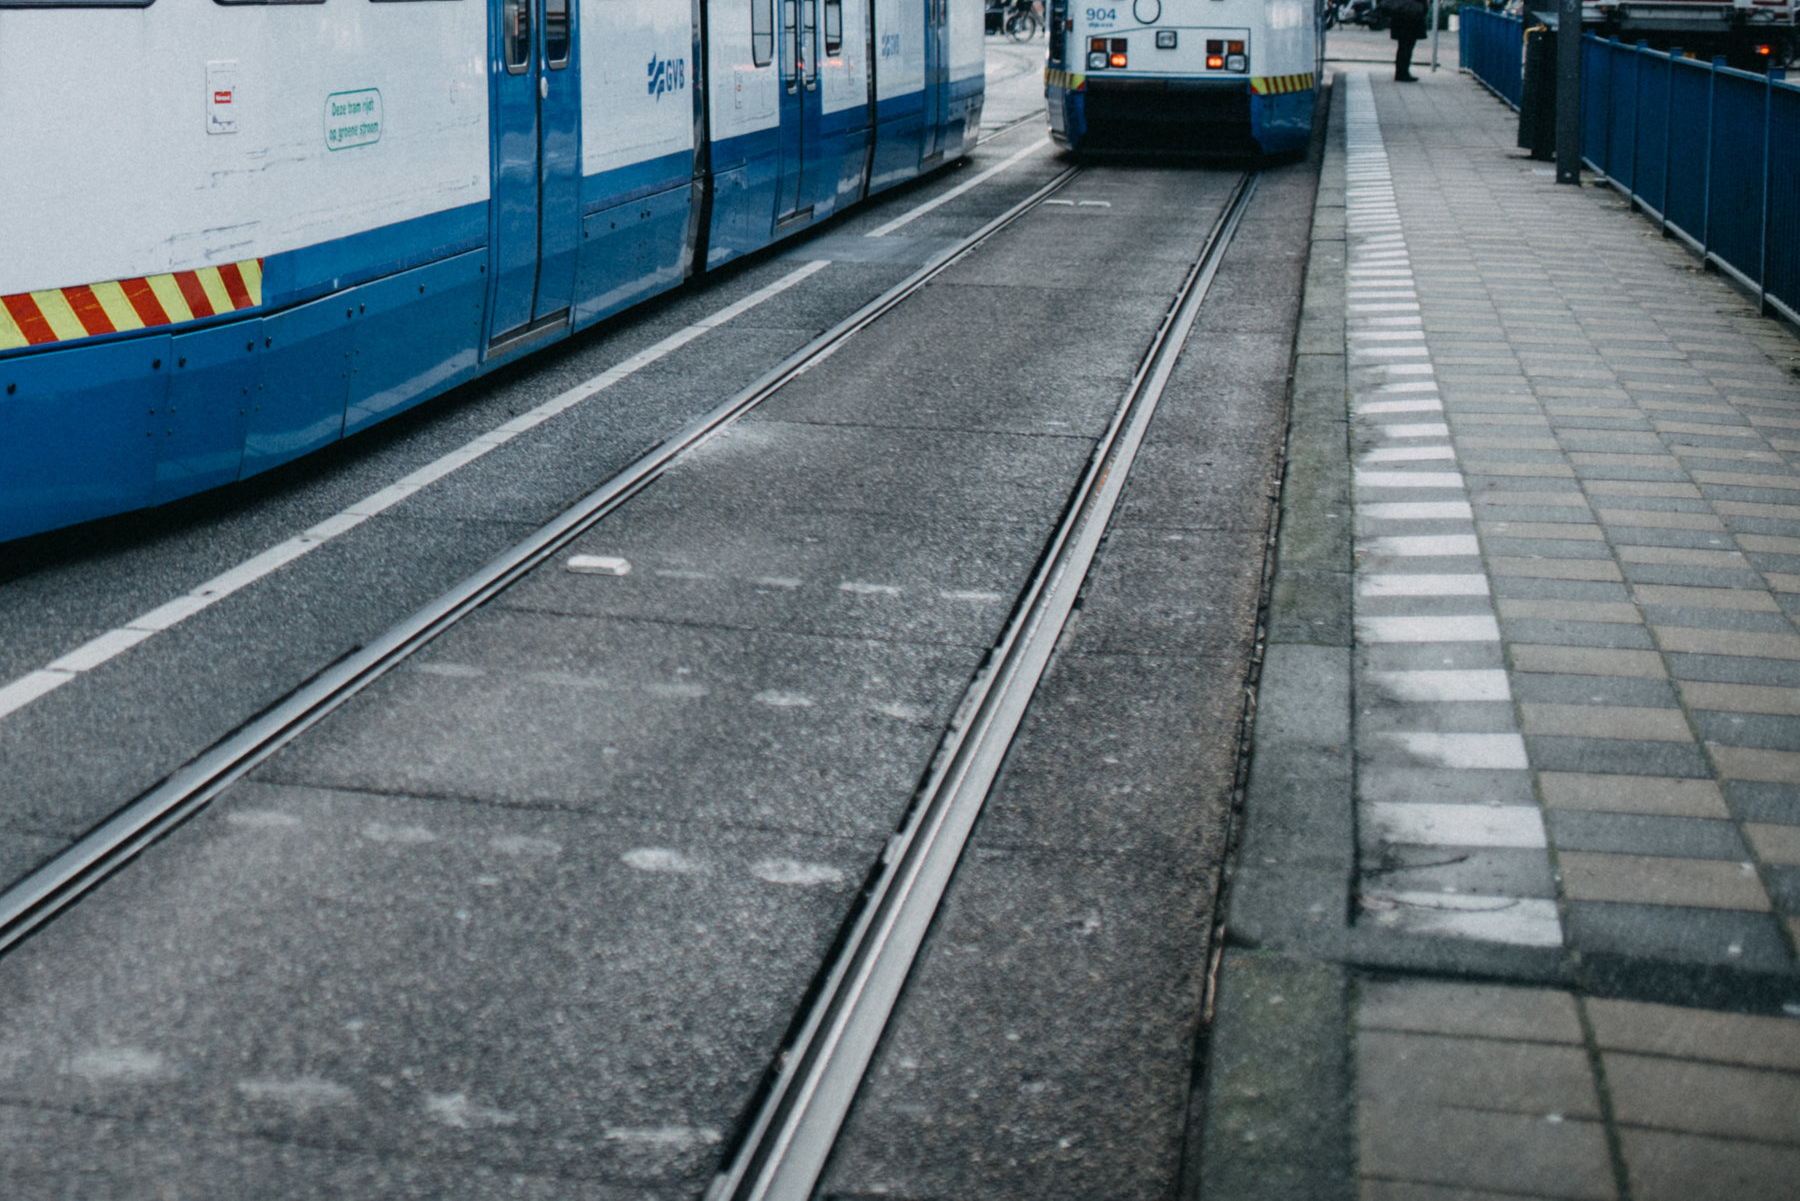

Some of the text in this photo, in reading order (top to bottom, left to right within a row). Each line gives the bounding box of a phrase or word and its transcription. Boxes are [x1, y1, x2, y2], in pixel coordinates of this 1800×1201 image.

[1086, 8, 1116, 20] 904
[665, 58, 685, 92] GVB
[332, 97, 374, 116] Deze tram rijdt
[329, 122, 378, 142] op groene stroom
